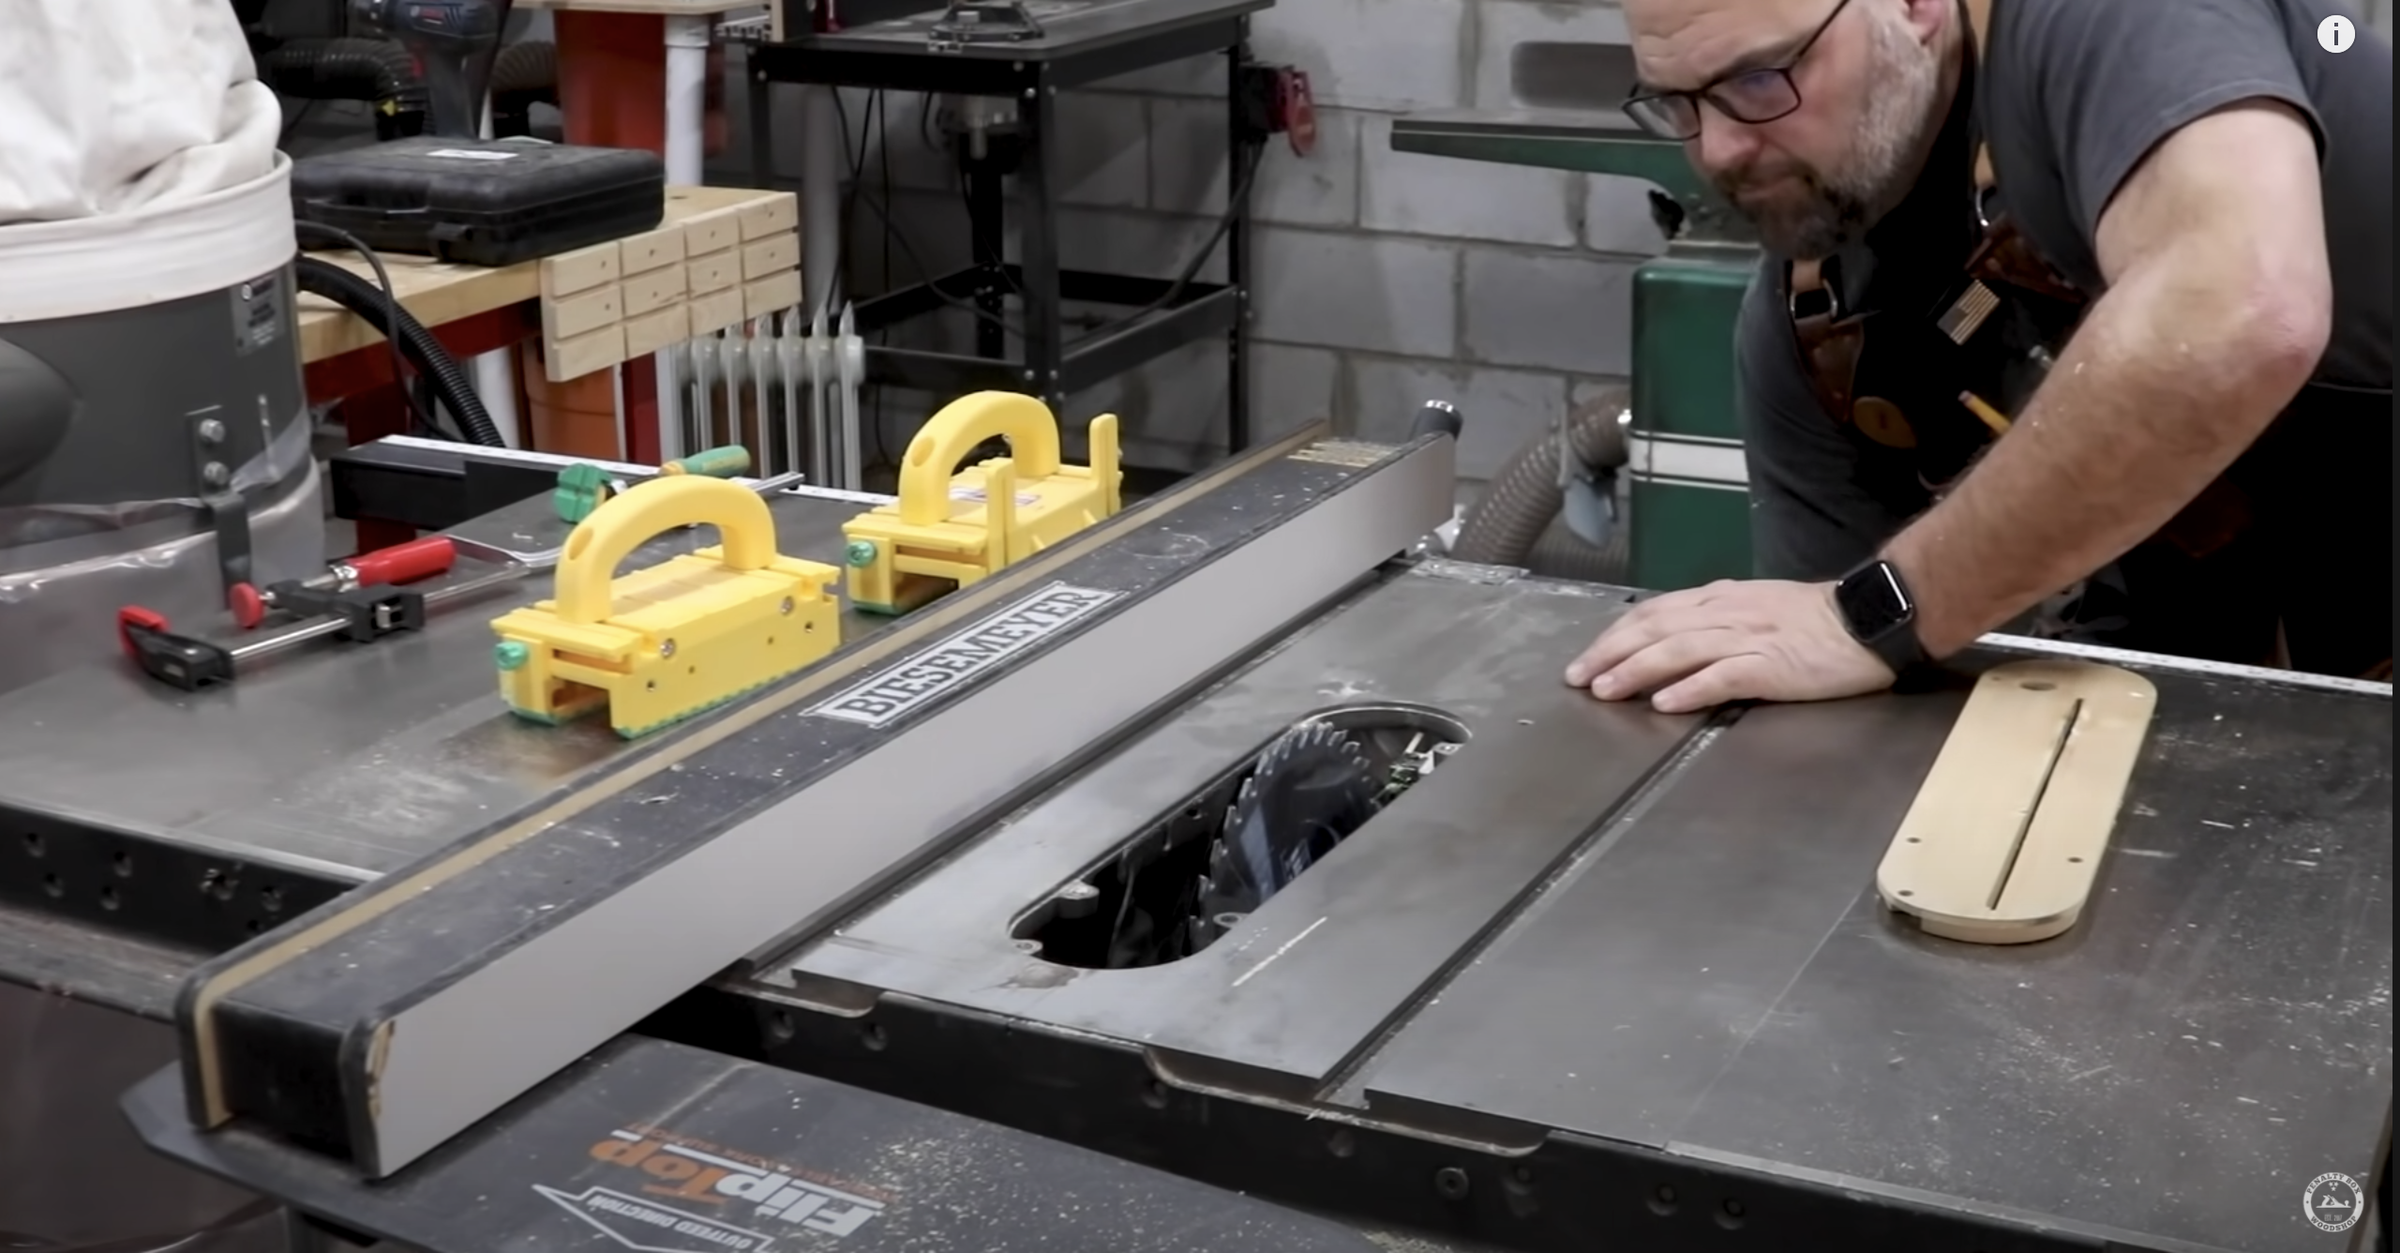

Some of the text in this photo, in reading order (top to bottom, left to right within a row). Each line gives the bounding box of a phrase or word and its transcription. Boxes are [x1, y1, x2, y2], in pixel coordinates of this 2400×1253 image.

[833, 590, 1100, 718] BIESEMEYER
[586, 1195, 754, 1250] OUTFEED DIRECTION
